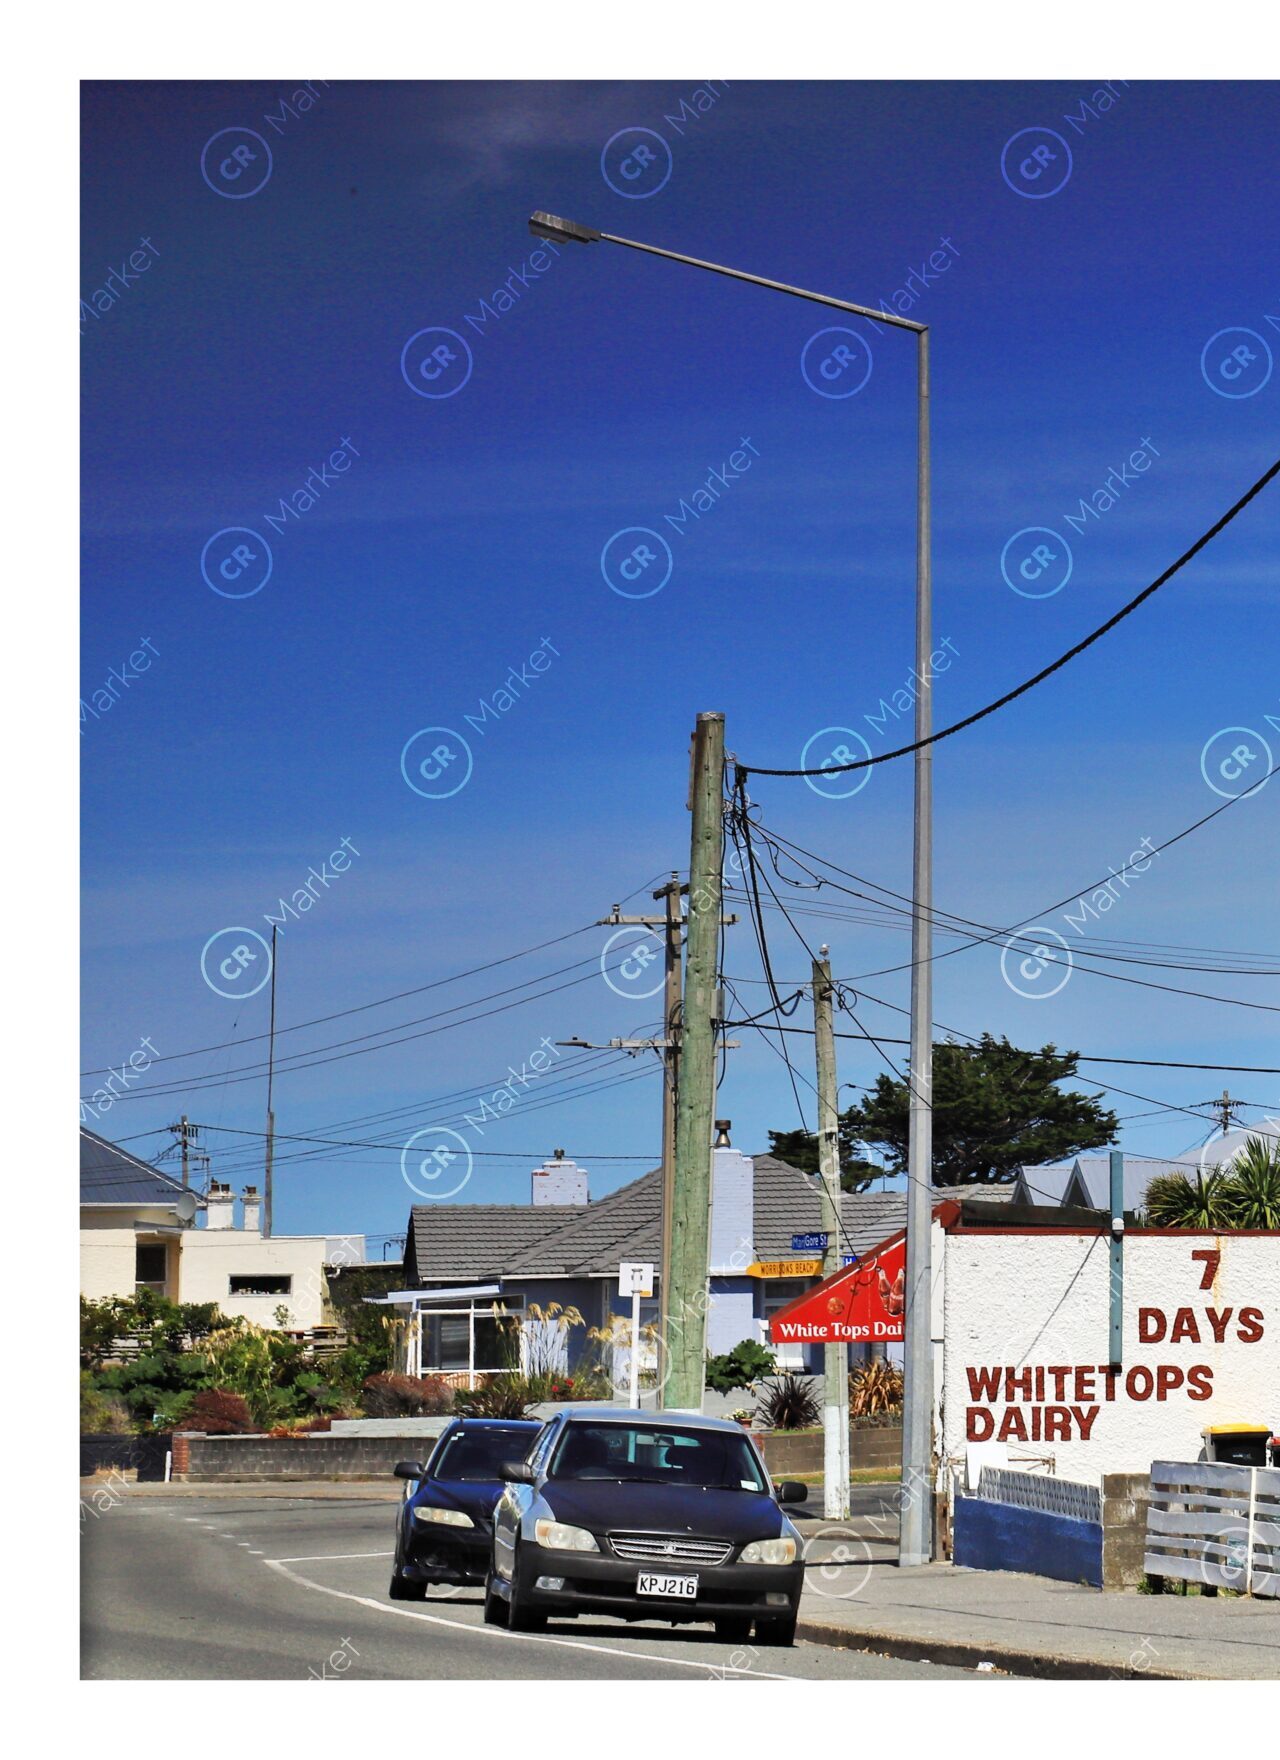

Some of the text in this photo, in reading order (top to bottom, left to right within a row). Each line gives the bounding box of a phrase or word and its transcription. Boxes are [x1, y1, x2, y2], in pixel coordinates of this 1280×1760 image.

[805, 1233, 827, 1247] Gore St
[760, 1261, 814, 1275] MORRISONS BEACH
[1191, 1249, 1221, 1290] 7
[779, 1321, 902, 1340] White Tops Dai
[1138, 1307, 1265, 1344] DAYS
[965, 1365, 1214, 1402] WHITETOPS
[966, 1405, 1101, 1442] DAIRY
[639, 1577, 695, 1595] KPJ216
